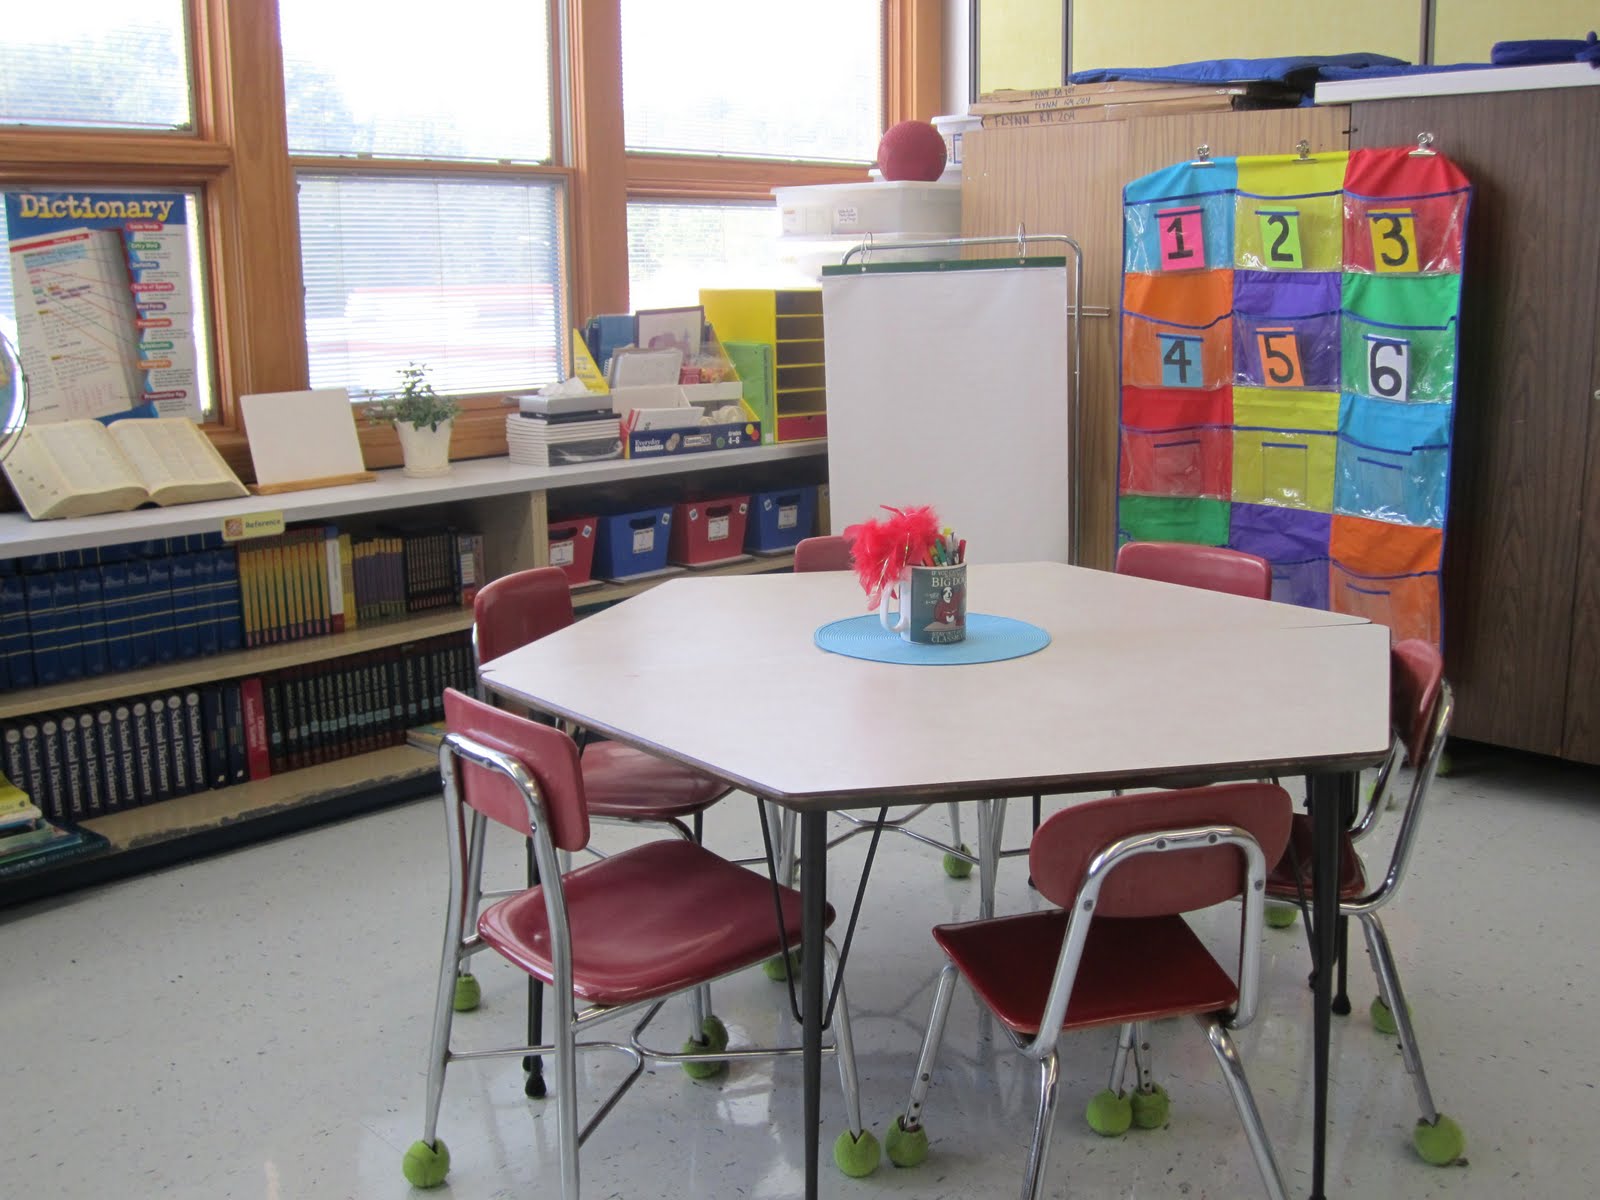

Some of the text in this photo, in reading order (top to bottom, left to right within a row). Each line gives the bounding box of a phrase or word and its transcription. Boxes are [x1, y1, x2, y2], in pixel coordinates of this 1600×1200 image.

[994, 114, 1030, 128] FLYNN
[1057, 111, 1075, 123] 204
[20, 194, 174, 222] Dictionary
[1167, 218, 1194, 260] 1
[1268, 215, 1294, 262] 2
[1372, 211, 1410, 267] 3
[1163, 339, 1192, 384] 4
[1264, 333, 1295, 384] 5
[1370, 341, 1404, 397] 6
[635, 438, 661, 446] Everyday
[246, 519, 281, 528] Reference
[932, 577, 951, 588] BIG
[9, 743, 23, 775] School
[27, 739, 41, 771] School
[66, 731, 82, 812] School Dictionary
[84, 728, 100, 808] School Dictionary
[102, 724, 118, 804] School Dictionary
[120, 721, 135, 800] School Dictionary
[137, 717, 152, 795] School Dictionary
[154, 713, 169, 791] School Dictionary
[171, 709, 186, 787] School Dictionary
[190, 706, 204, 784] School Dictionary
[47, 735, 64, 816] School Dictionary
